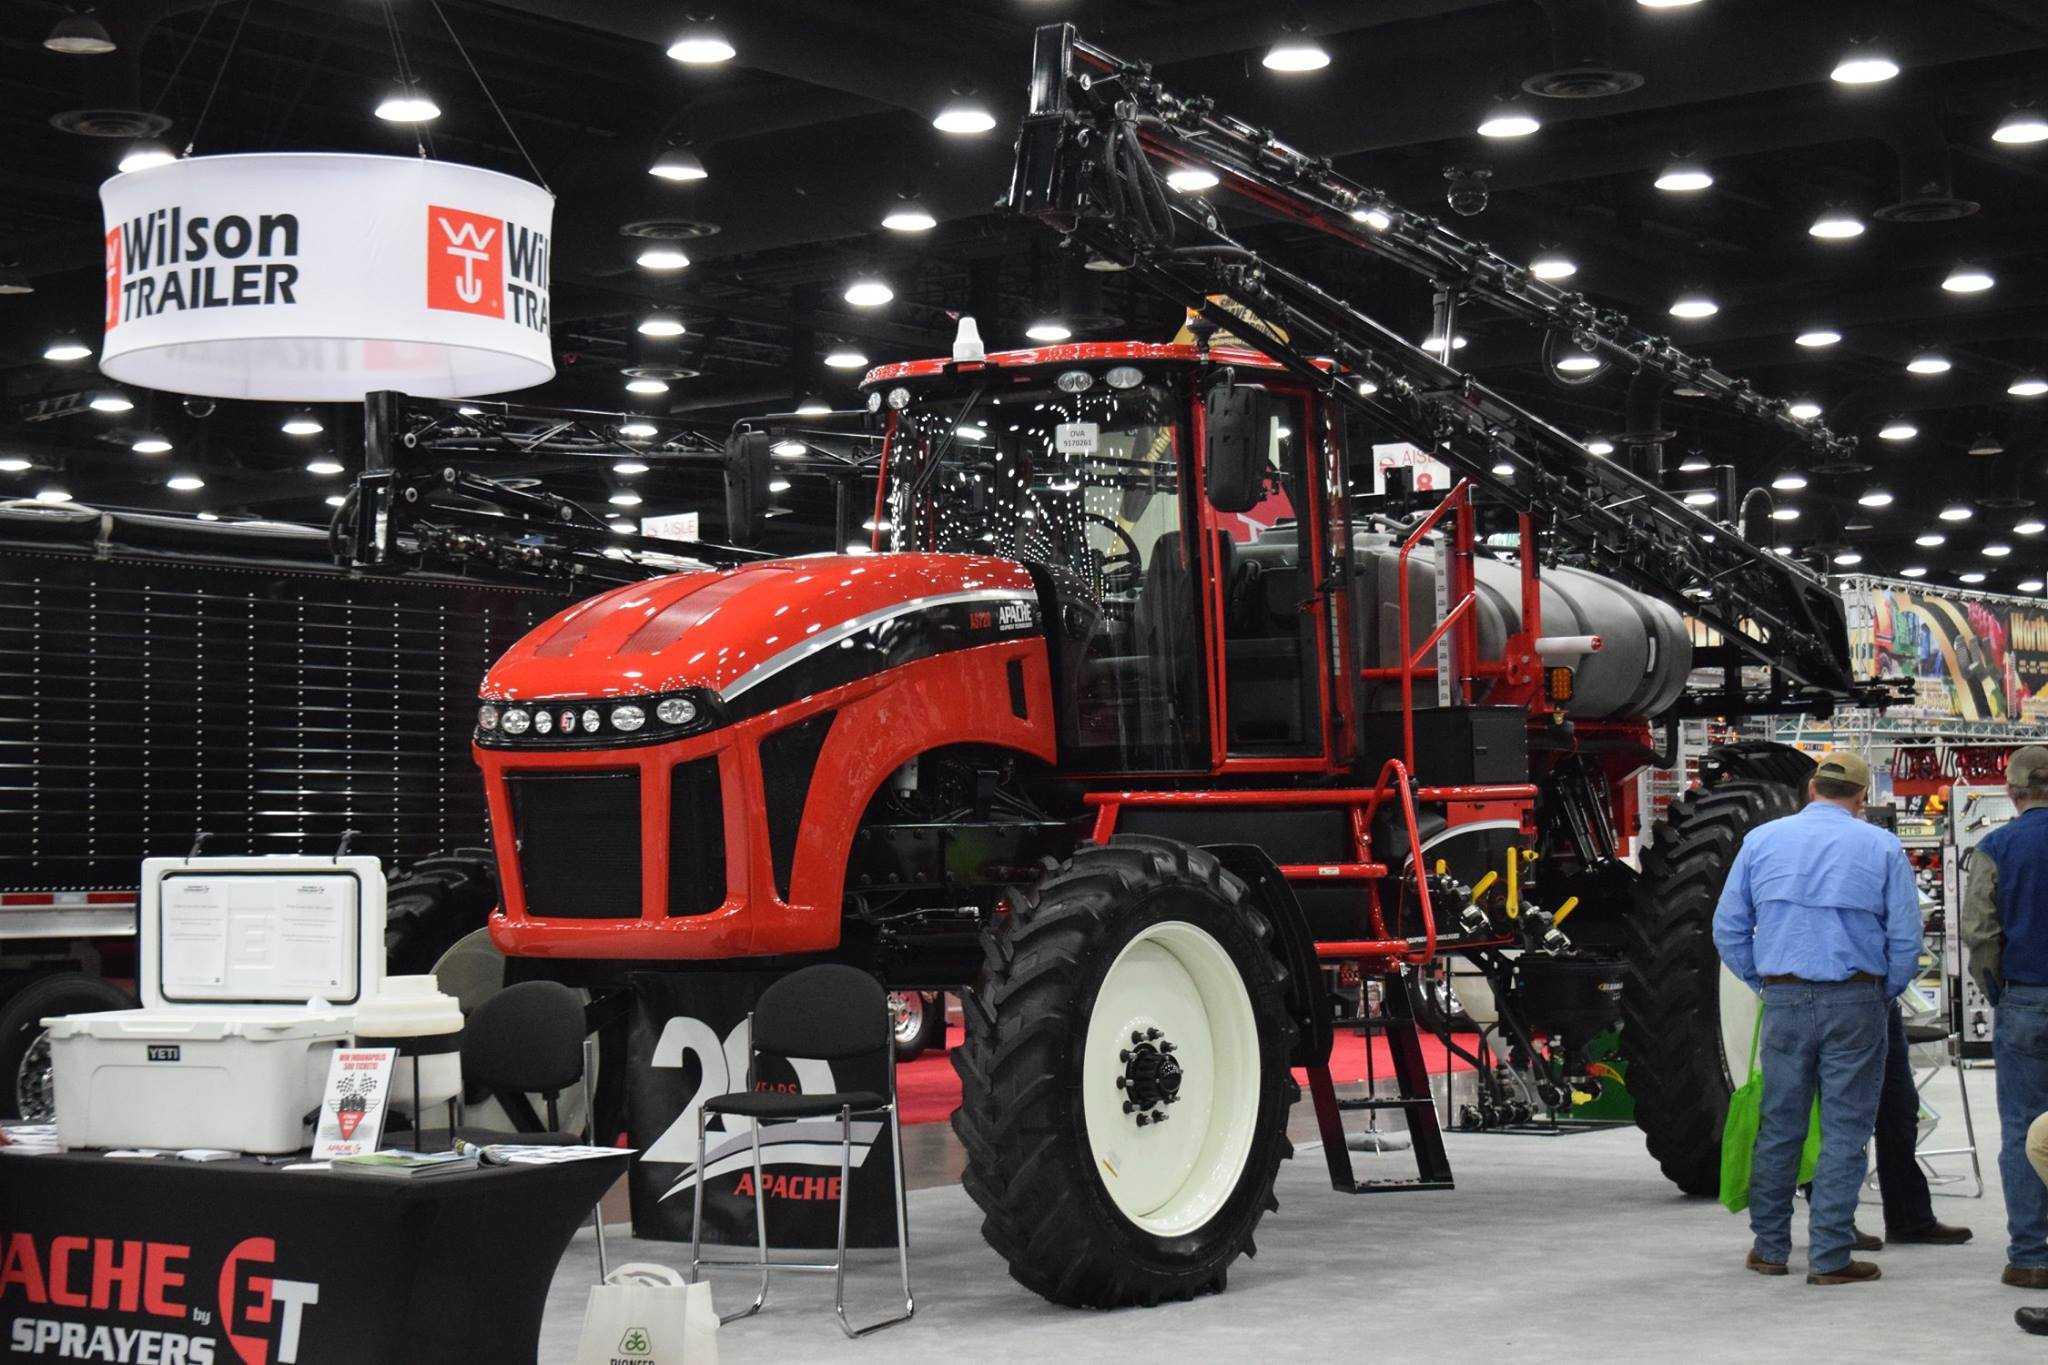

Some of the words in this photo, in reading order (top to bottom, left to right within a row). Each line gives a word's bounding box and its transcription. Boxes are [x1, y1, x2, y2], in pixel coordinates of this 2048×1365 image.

[123, 206, 298, 275] Wilson
[507, 221, 549, 290] Wil
[123, 263, 299, 322] TRAILER
[508, 282, 549, 333] TRA
[999, 603, 1033, 625] APACHE
[149, 1047, 178, 1060] YETI
[733, 1172, 843, 1200] APACHE
[0, 1232, 191, 1318] ACHE
[10, 1317, 216, 1365] SPRAYERS
[193, 1307, 211, 1326] by
